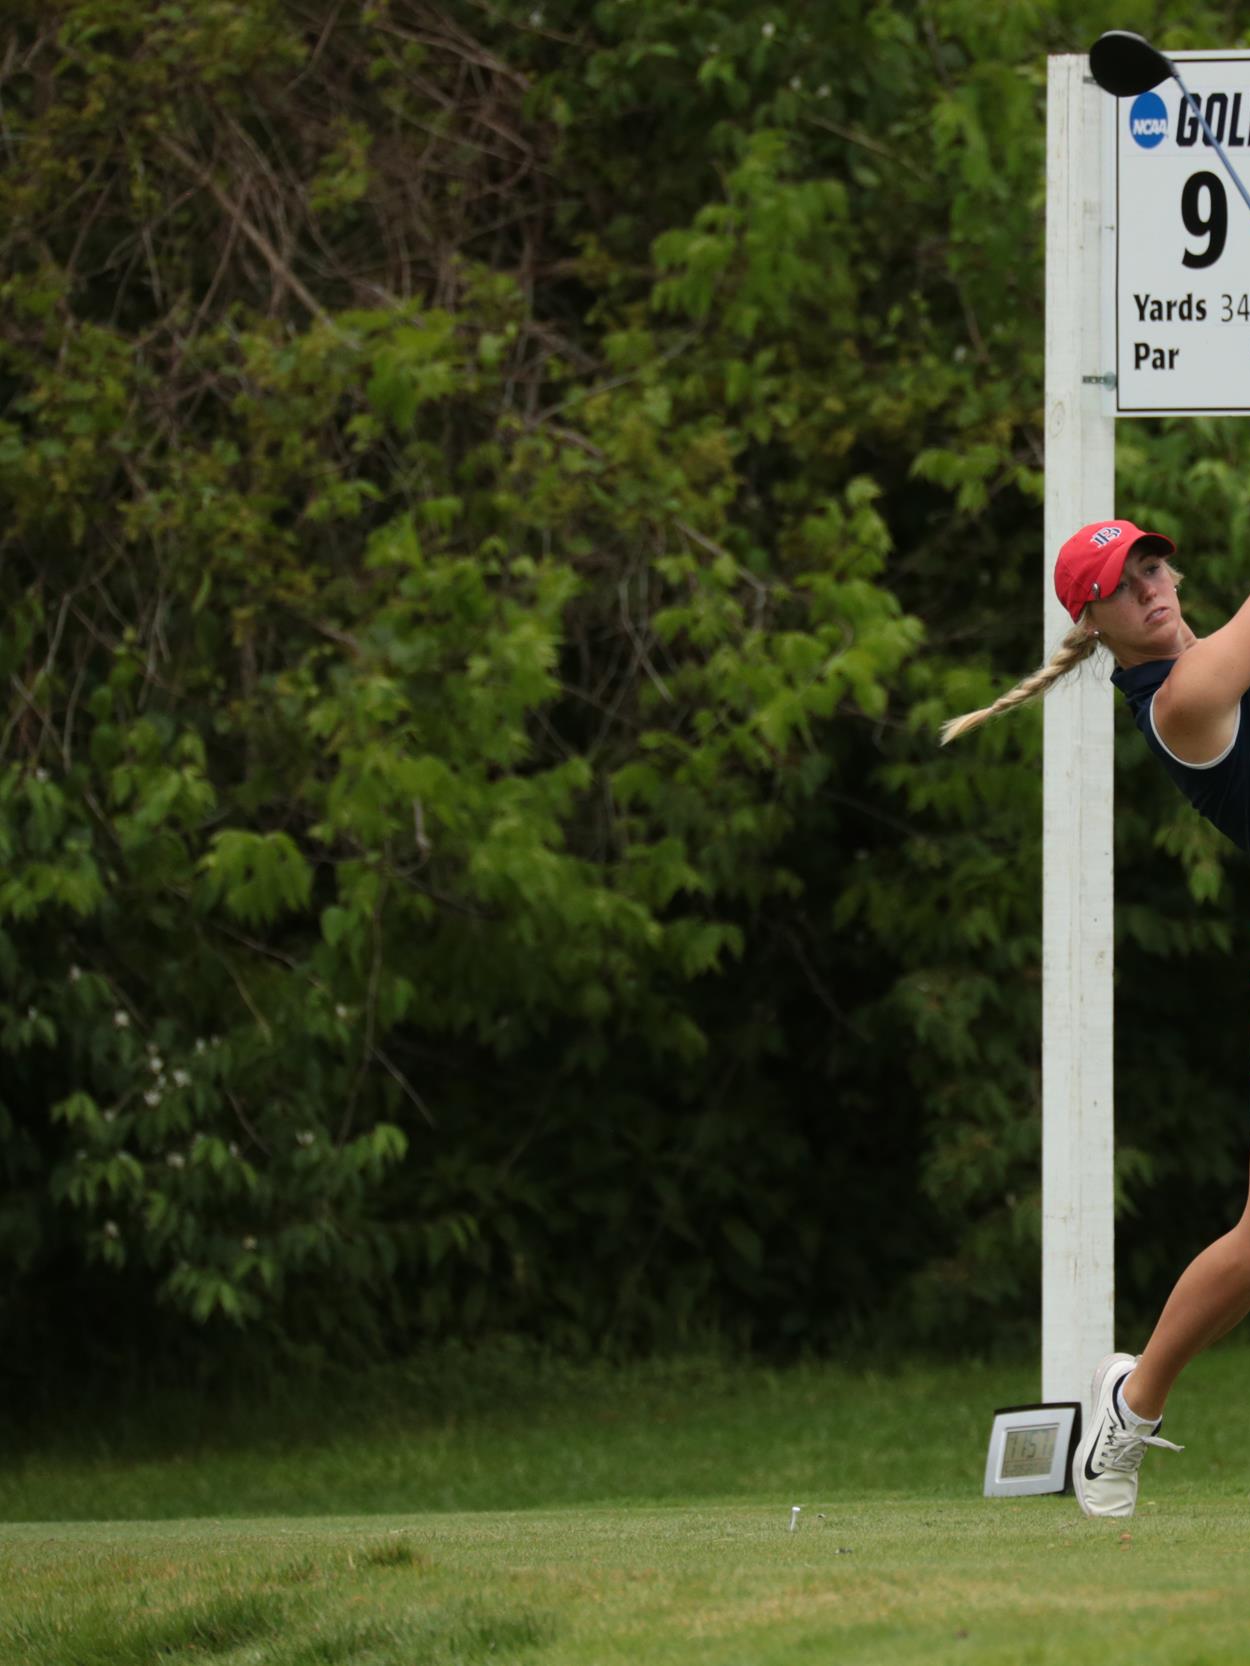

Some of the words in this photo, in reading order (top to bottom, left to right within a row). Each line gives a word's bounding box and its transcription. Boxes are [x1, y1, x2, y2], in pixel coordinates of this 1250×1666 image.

[1133, 118, 1168, 136] NCAA
[1181, 170, 1228, 269] 9
[1133, 293, 1207, 322] Yards
[1134, 342, 1179, 370] Par
